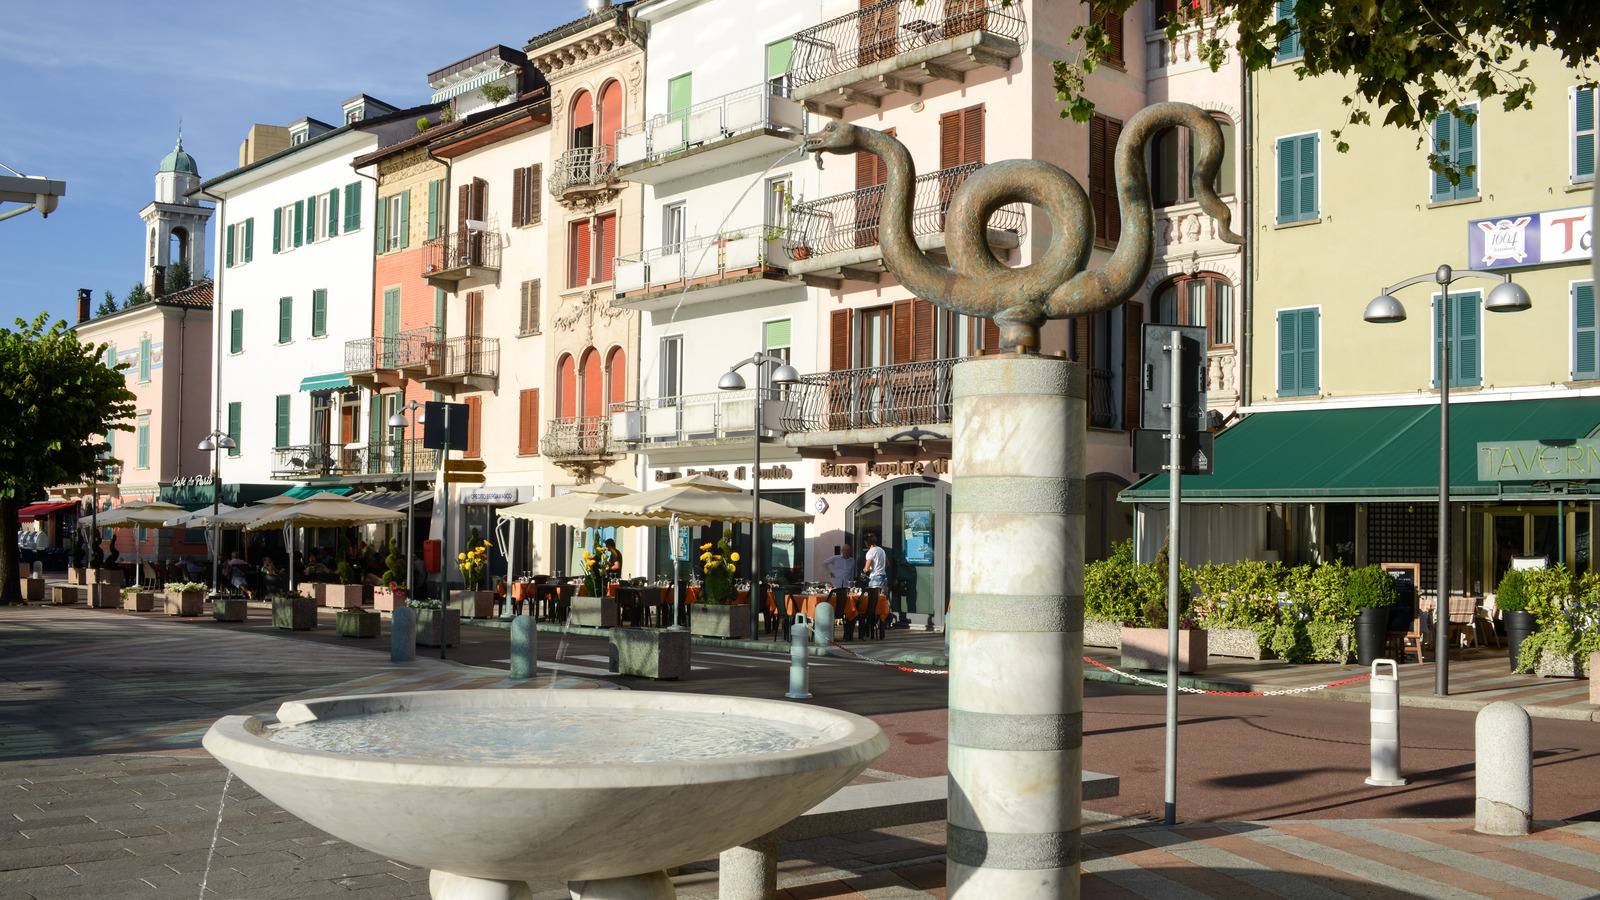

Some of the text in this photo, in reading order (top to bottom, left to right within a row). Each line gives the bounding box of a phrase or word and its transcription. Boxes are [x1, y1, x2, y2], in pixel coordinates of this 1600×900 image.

[734, 466, 746, 481] di
[933, 458, 949, 474] di
[811, 483, 859, 494] BANCOMAT
